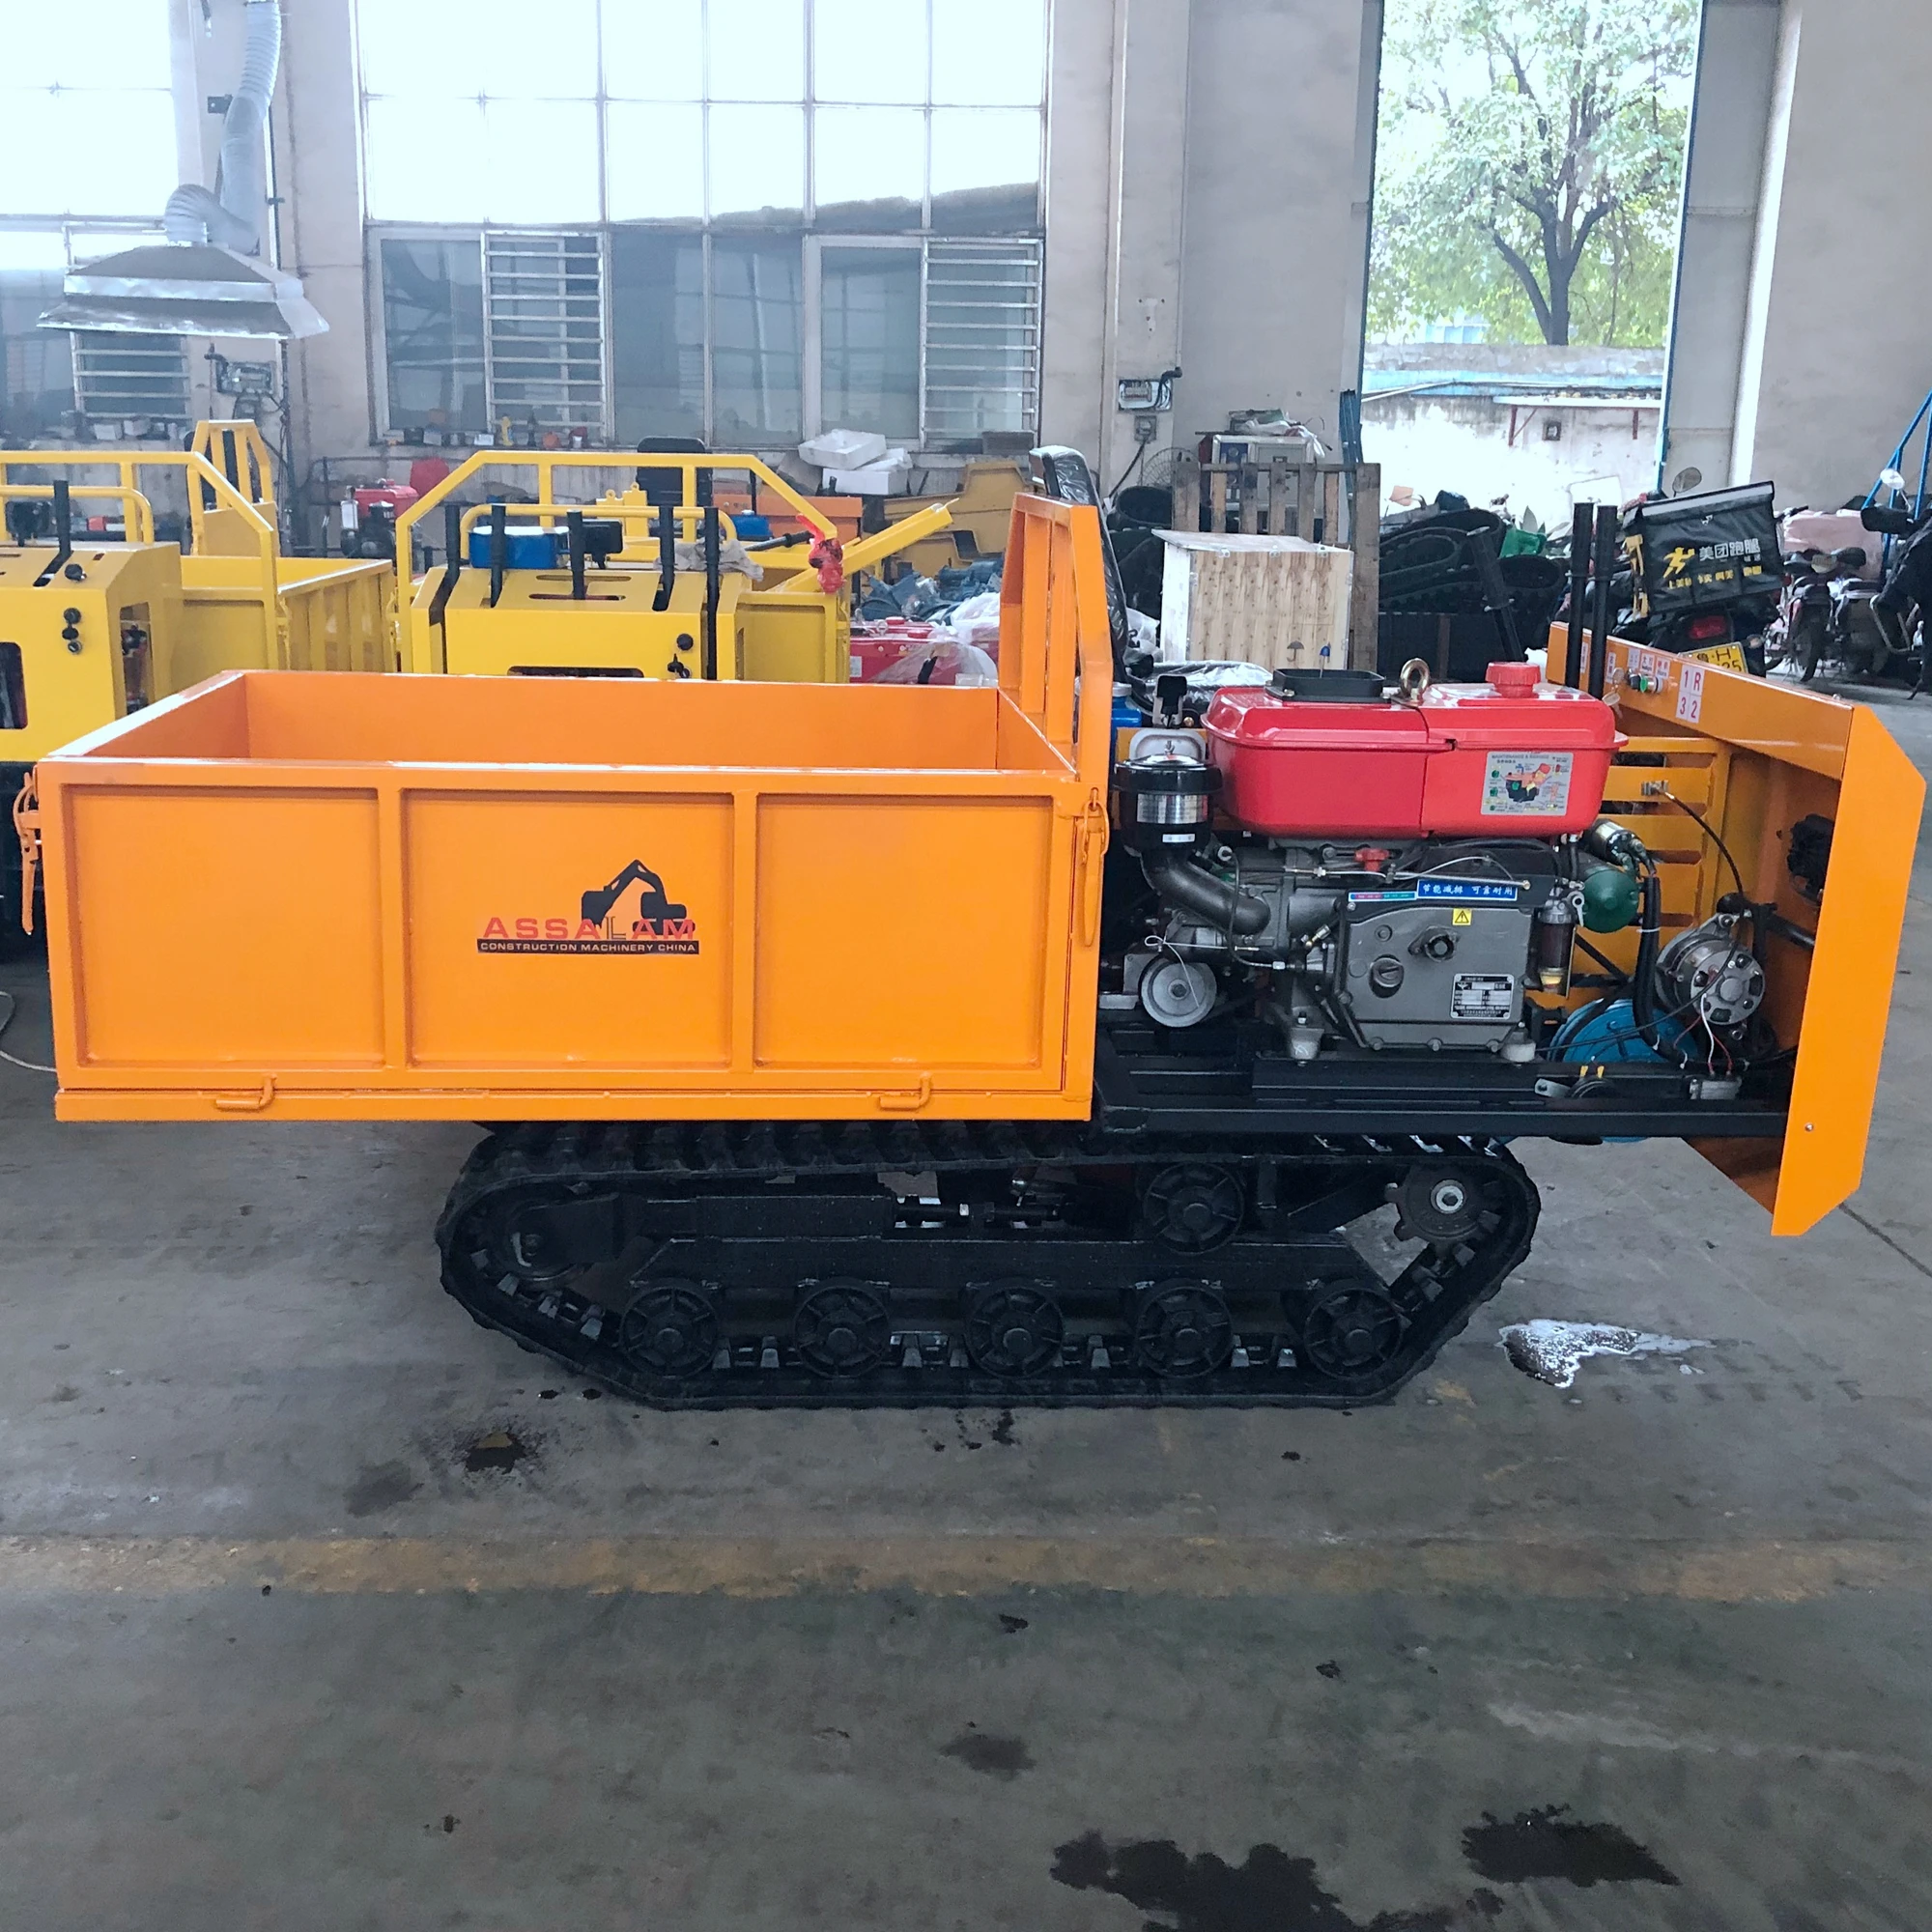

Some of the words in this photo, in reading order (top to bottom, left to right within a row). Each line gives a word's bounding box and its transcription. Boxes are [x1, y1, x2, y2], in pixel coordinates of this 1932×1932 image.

[1699, 538, 1761, 561] 美团跑腿
[1684, 669, 1689, 688] 1
[1693, 671, 1701, 692] R
[1679, 696, 1687, 715] 3
[1690, 700, 1698, 719] 2
[1422, 883, 1463, 895] 节能减排
[483, 917, 694, 941] ASSALAM
[480, 942, 578, 952] CONSTRUCTION
[581, 943, 654, 952] MACHINERY
[658, 944, 696, 952] CHINA
